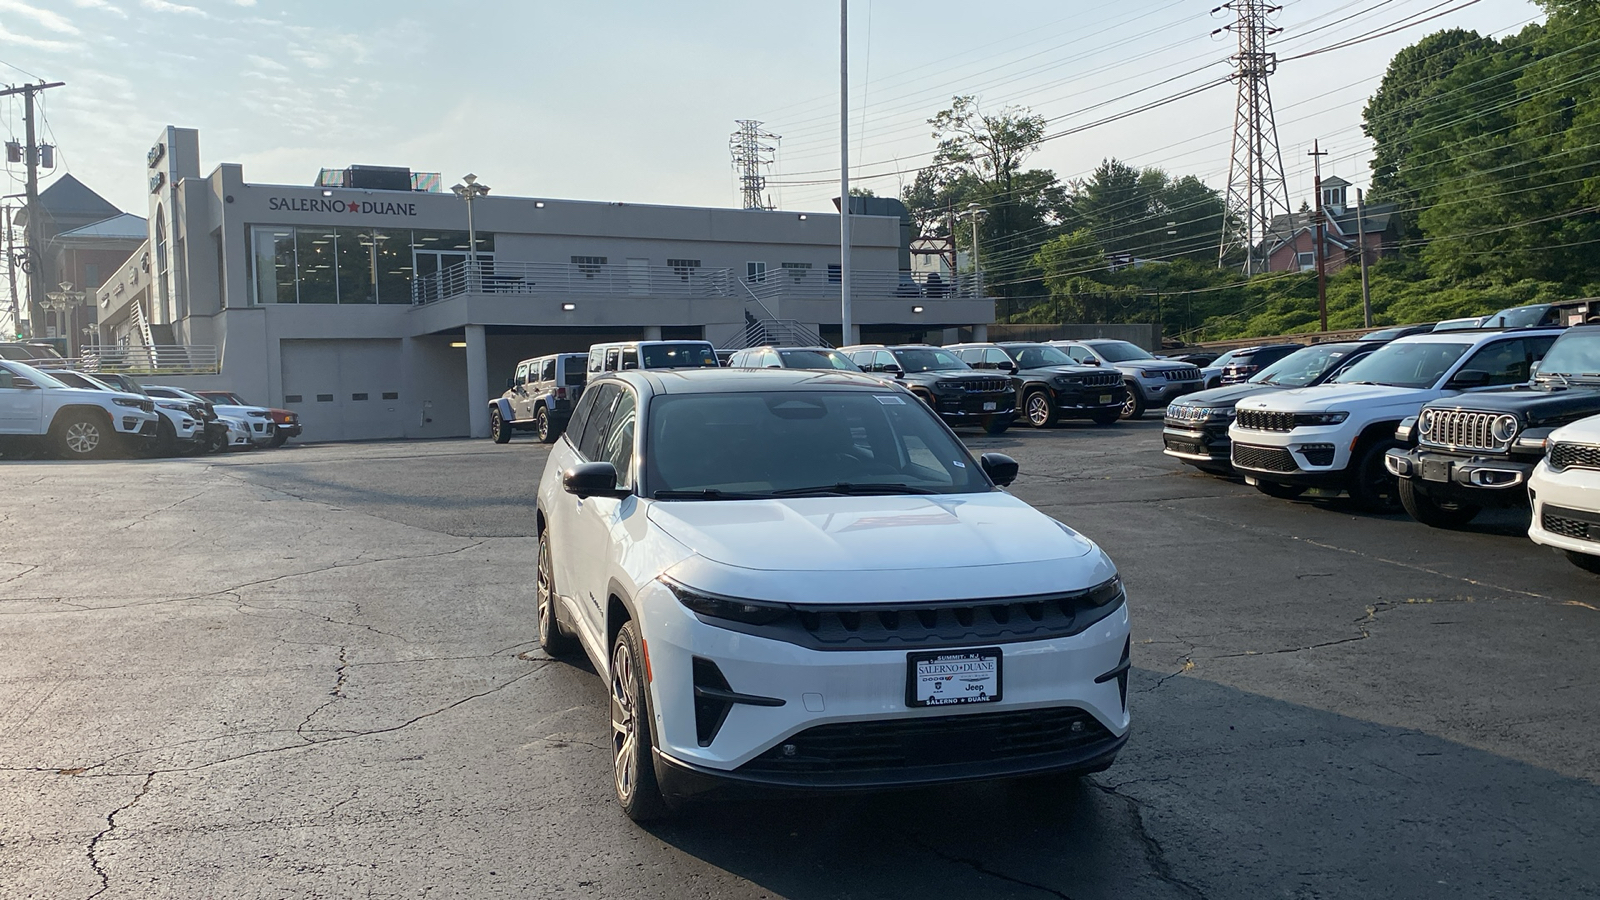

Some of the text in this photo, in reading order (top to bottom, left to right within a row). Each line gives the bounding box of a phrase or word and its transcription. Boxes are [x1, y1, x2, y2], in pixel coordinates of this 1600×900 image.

[269, 197, 417, 216] SALERNO DUANE
[918, 662, 994, 674] SALERNO DUANE
[926, 697, 958, 705] SALERNO
